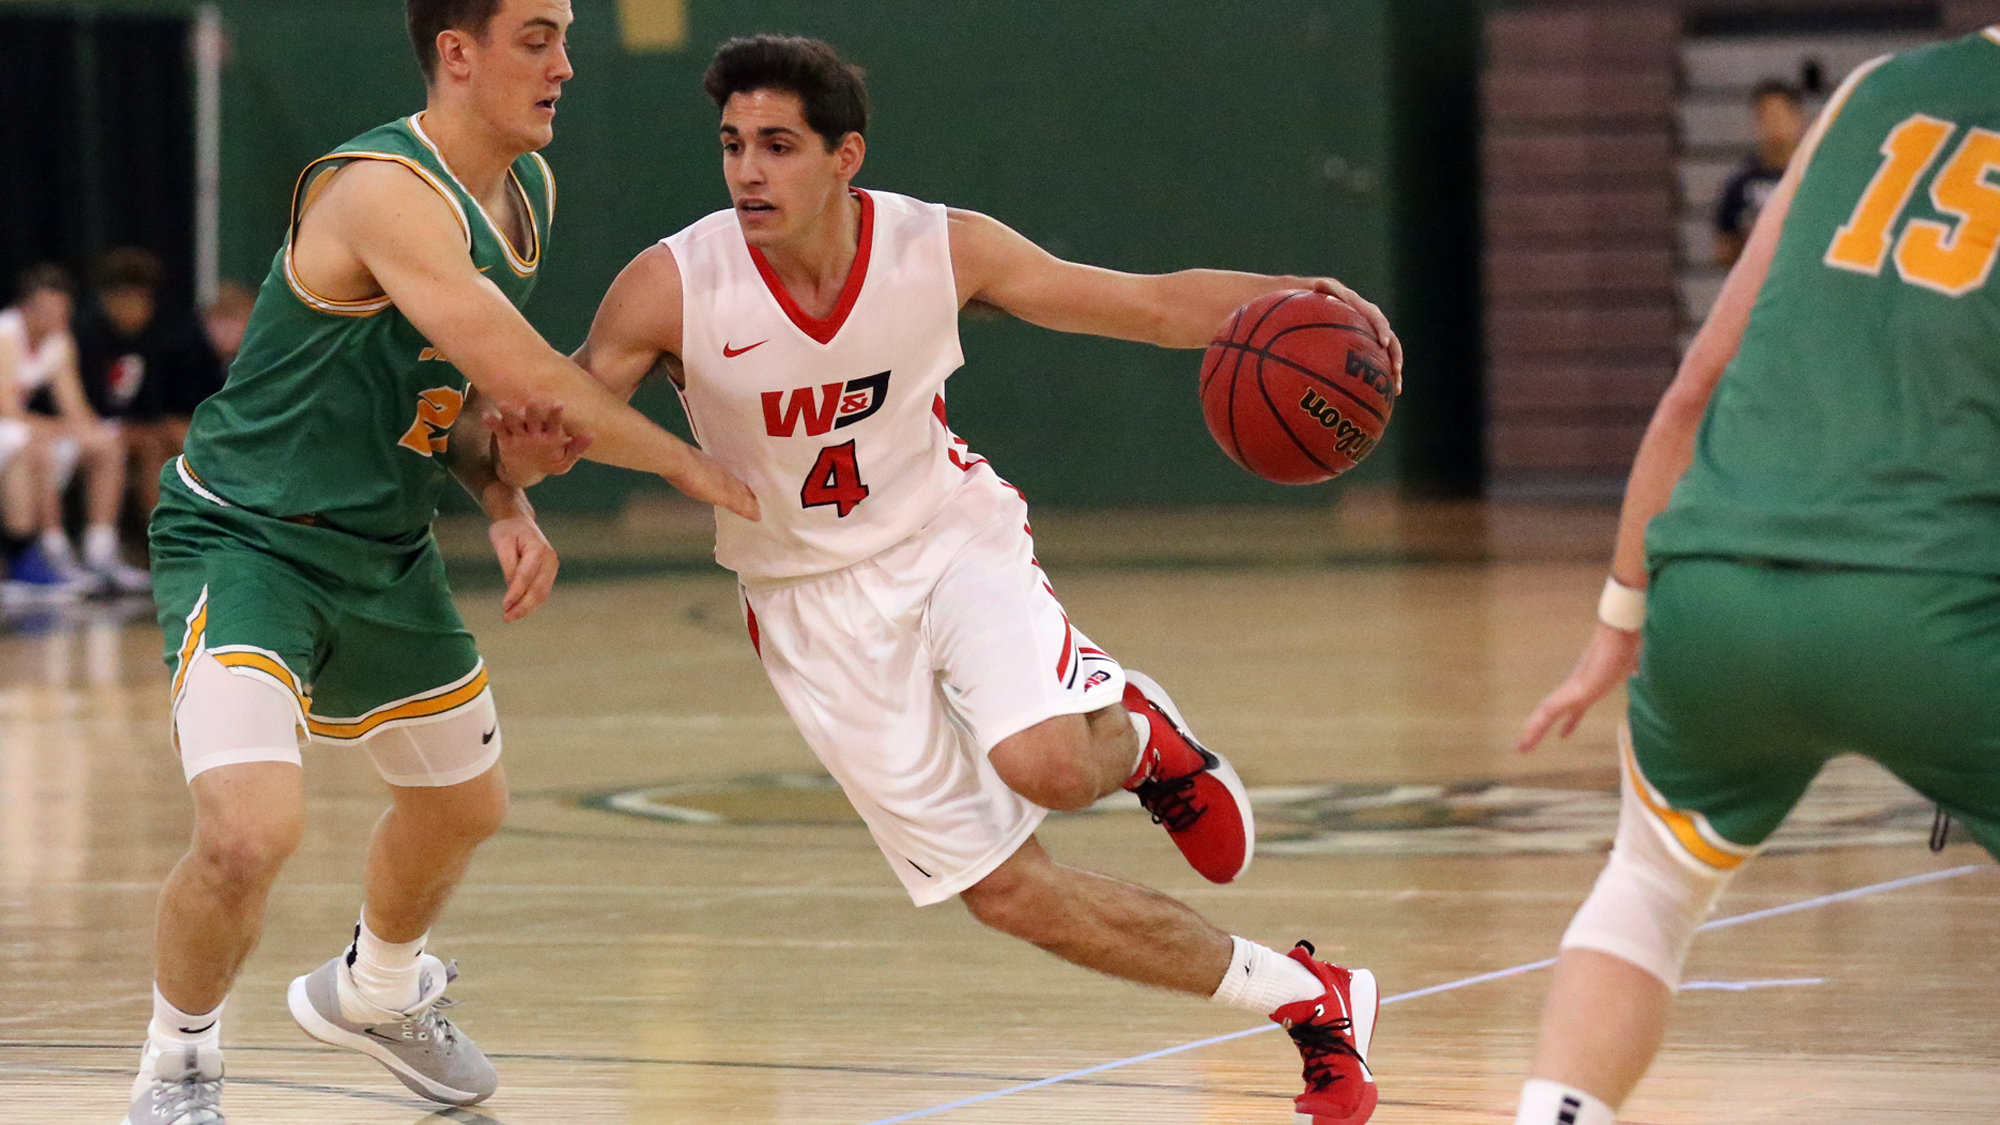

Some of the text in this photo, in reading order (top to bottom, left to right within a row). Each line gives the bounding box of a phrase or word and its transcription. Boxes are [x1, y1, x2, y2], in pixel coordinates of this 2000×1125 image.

[1823, 113, 2000, 296] 15
[761, 370, 891, 437] W&J
[800, 438, 869, 518] 4
